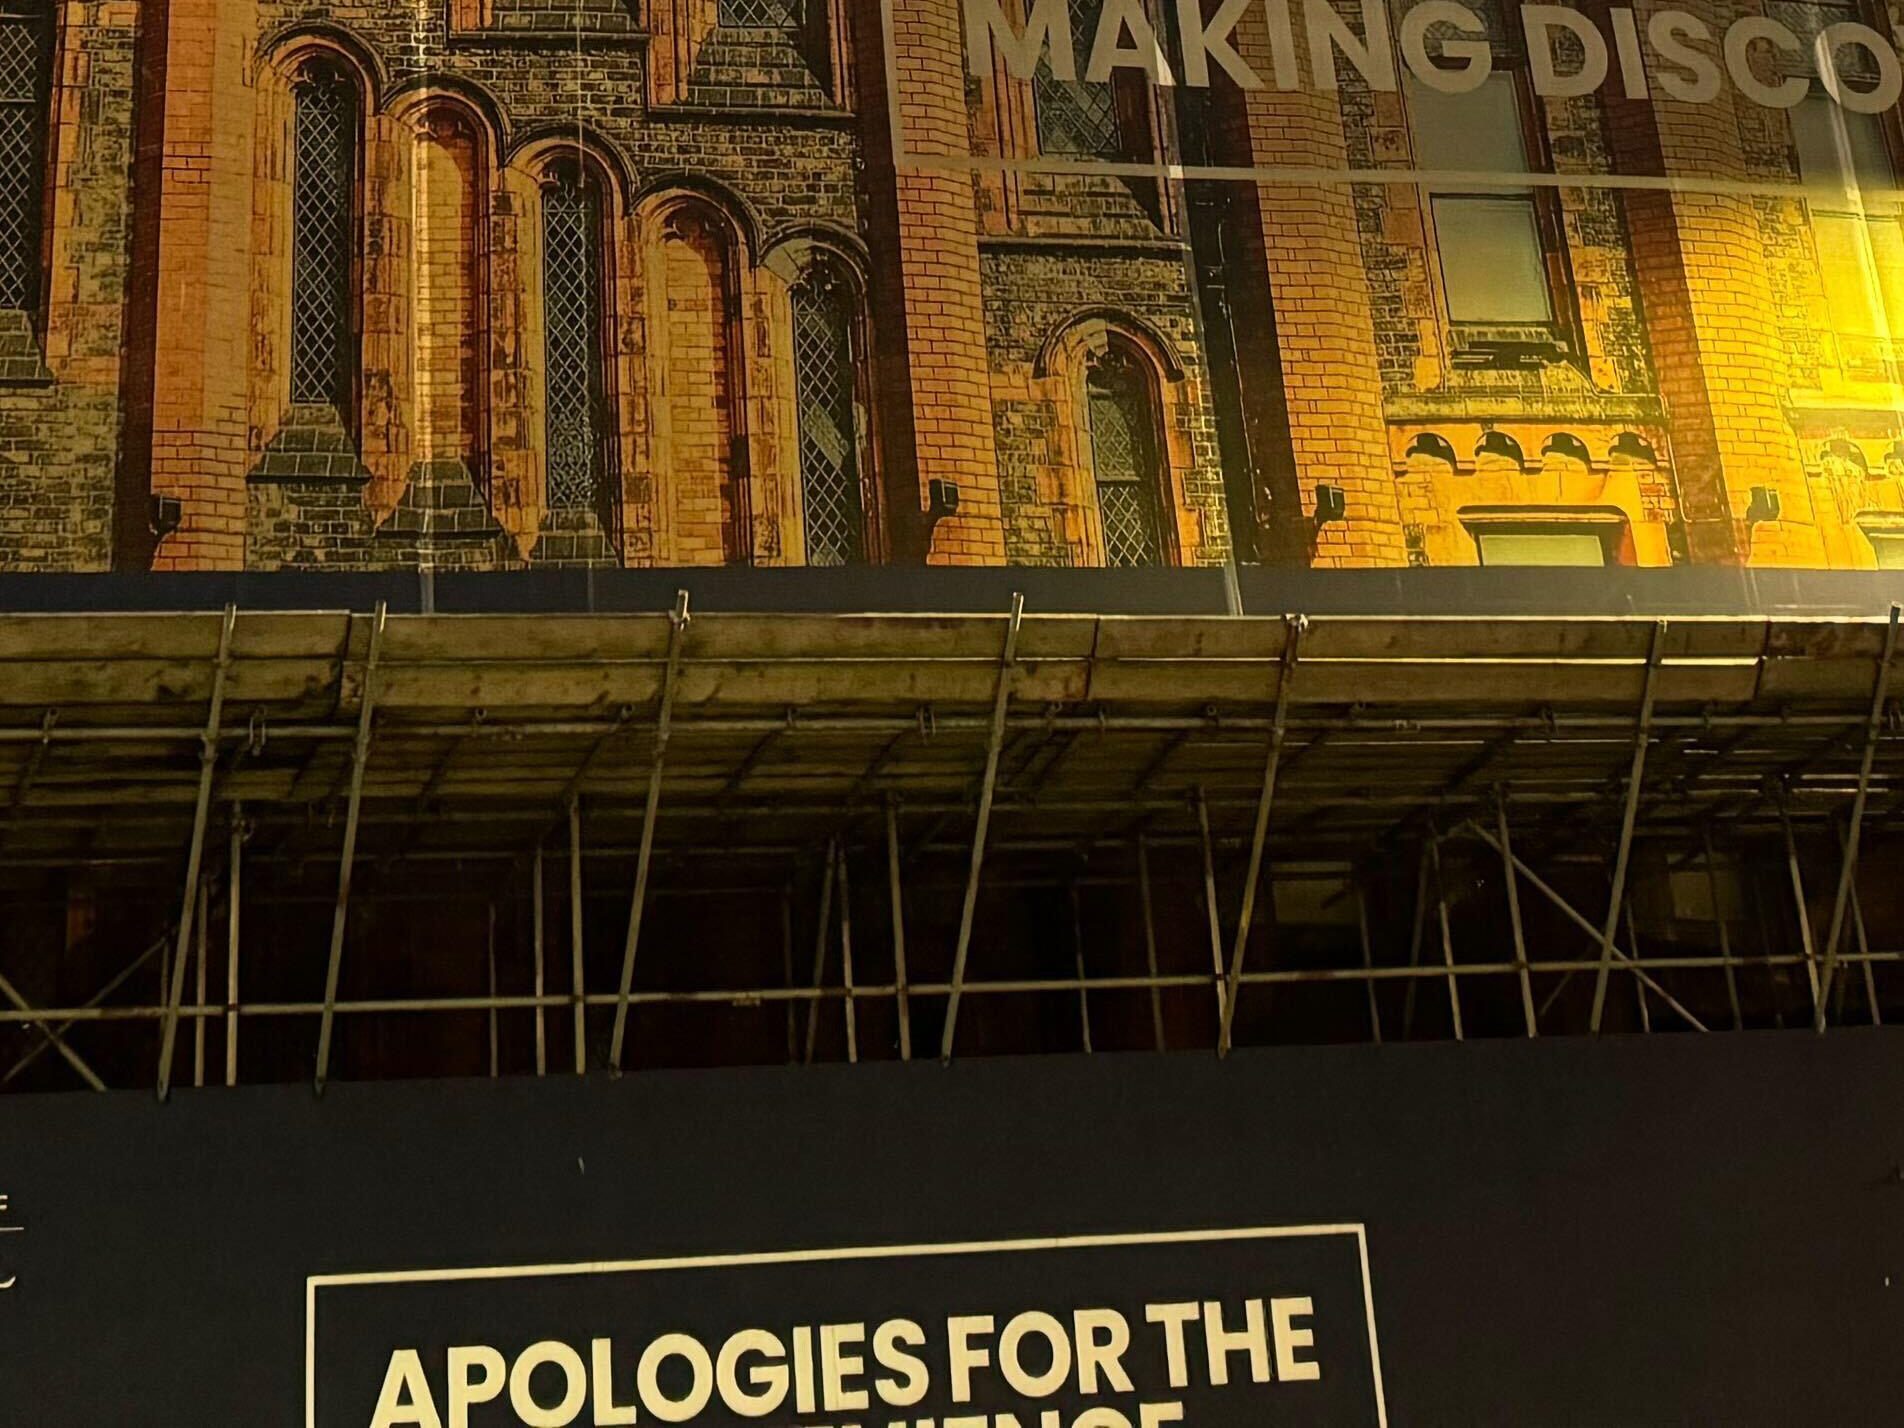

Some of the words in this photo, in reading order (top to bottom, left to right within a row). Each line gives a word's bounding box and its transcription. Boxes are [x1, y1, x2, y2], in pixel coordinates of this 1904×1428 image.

[369, 1317, 930, 1428] APOLOGIES
[948, 1307, 1133, 1404] FOR
[1145, 1296, 1321, 1390] THE
